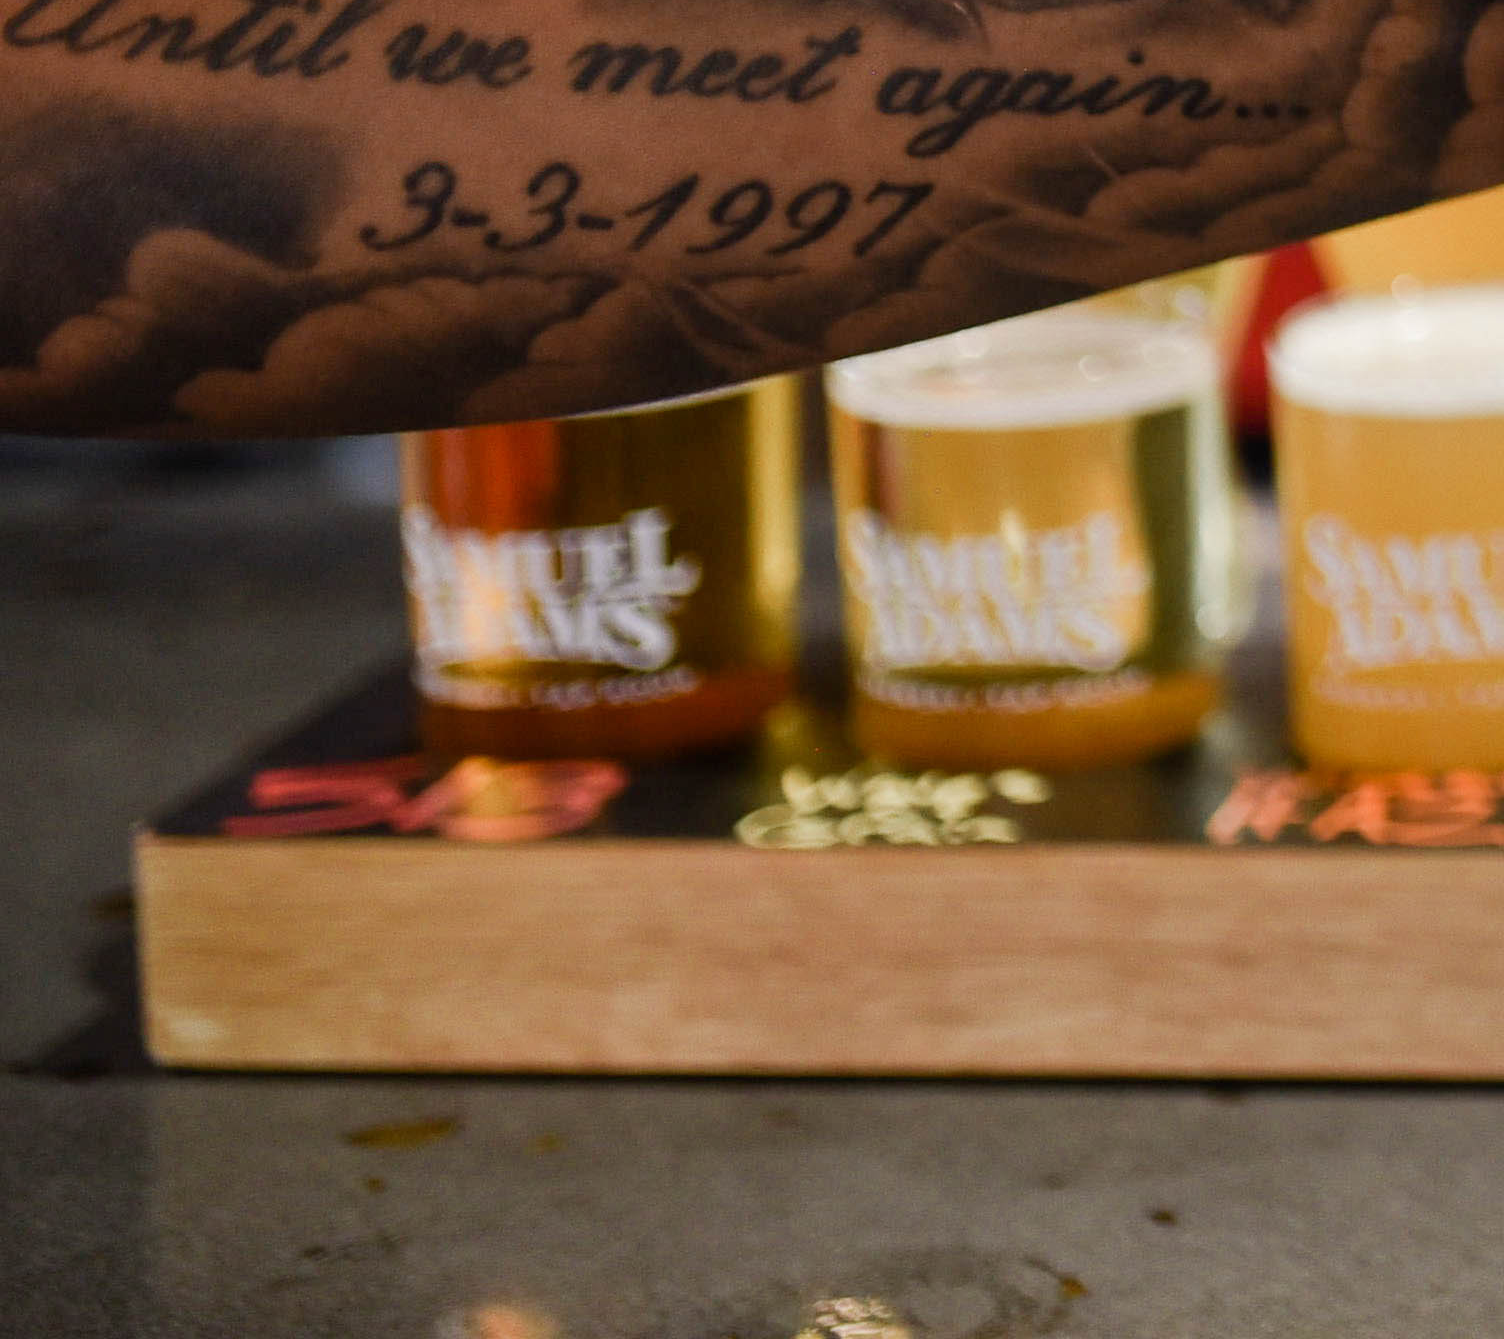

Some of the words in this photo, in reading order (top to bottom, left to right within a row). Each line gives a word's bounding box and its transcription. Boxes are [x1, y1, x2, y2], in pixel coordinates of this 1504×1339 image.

[385, 24, 532, 87] we
[569, 26, 863, 103] meet
[359, 161, 935, 258] 3-3-1997
